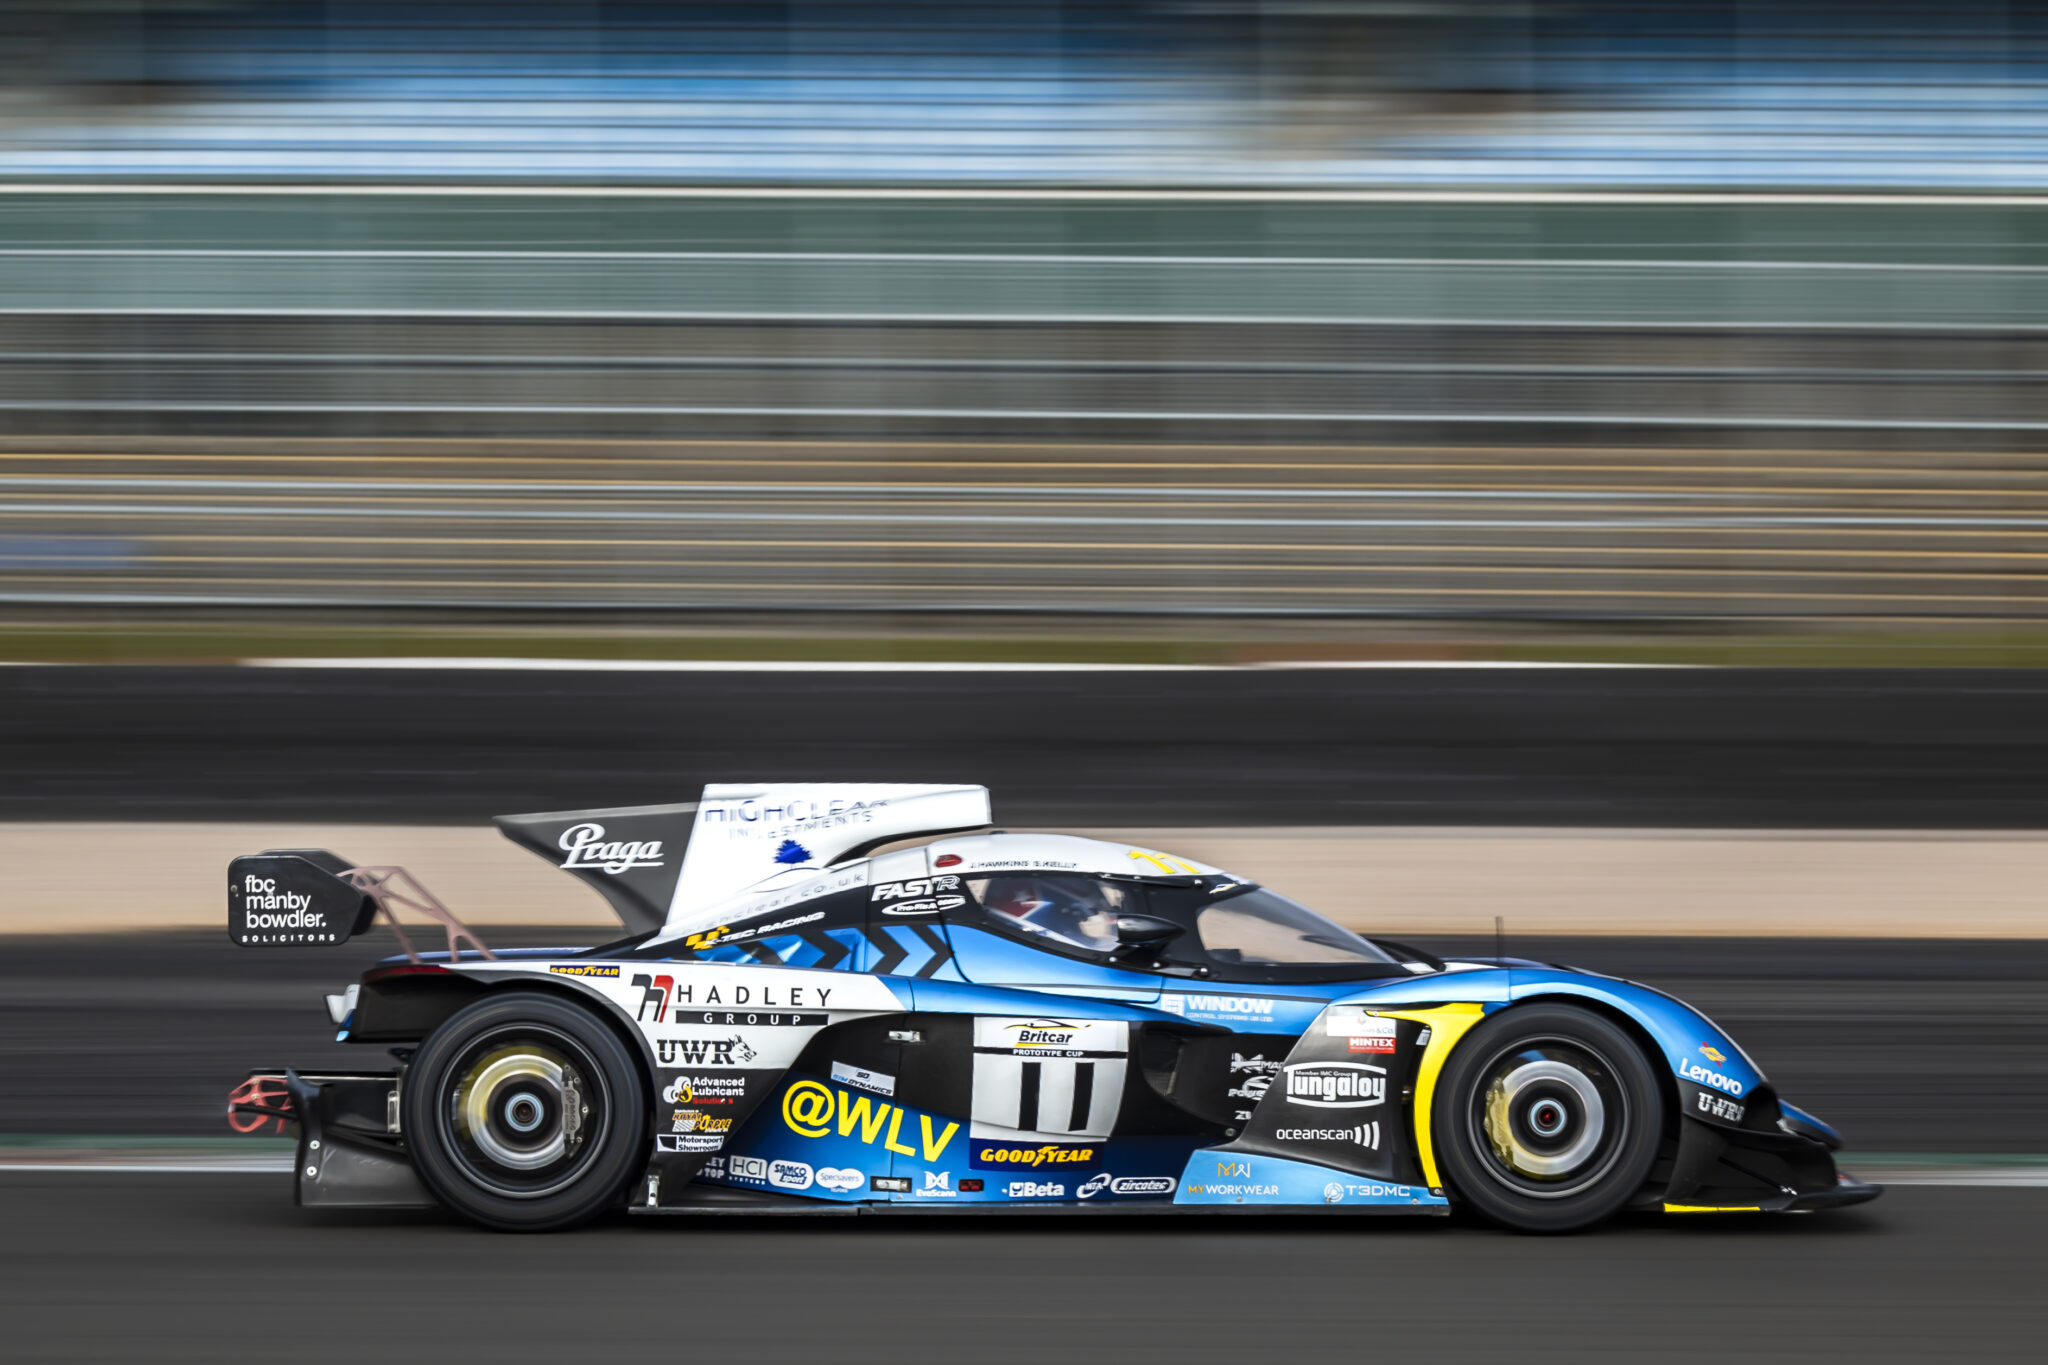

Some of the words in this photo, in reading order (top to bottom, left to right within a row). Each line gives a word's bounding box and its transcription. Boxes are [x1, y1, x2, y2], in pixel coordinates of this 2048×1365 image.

[729, 810, 872, 839] INESTMENTS
[559, 823, 664, 874] Praga
[245, 875, 276, 893] fbc
[246, 891, 312, 912] manby
[246, 910, 327, 928] bowdler.
[757, 912, 826, 935] RACING
[242, 934, 336, 943] SOLICITORS
[550, 966, 619, 976] GOODYEAR
[678, 984, 832, 1007] HADLEY
[1187, 995, 1275, 1014] WINDOW
[703, 1012, 801, 1026] GROUP
[1019, 1030, 1073, 1043] Britcar
[1350, 1038, 1393, 1047] MINTEX
[657, 1039, 735, 1065] UWR
[1013, 1048, 1062, 1057] PROTOTYPE
[1066, 1050, 1084, 1058] CUP
[693, 1077, 745, 1086] Advanced
[1283, 1062, 1387, 1104] Tungaloy
[1680, 1057, 1742, 1095] Lenovo
[693, 1087, 745, 1096] Lubricant
[848, 1079, 893, 1095] DYNAMICS
[693, 1097, 734, 1105] Solutios
[1018, 1062, 1095, 1132] 11
[782, 1080, 960, 1162] @WLV
[679, 1136, 723, 1145] Motorsport
[1276, 1129, 1354, 1140] oceanscan
[980, 1146, 1093, 1167] GOODYEAR
[732, 1158, 763, 1176] HCI
[774, 1164, 807, 1176] SAMCO
[820, 1172, 860, 1182] Specsavers
[1024, 1182, 1064, 1197] Beta
[1346, 1185, 1410, 1197] T3DMC
